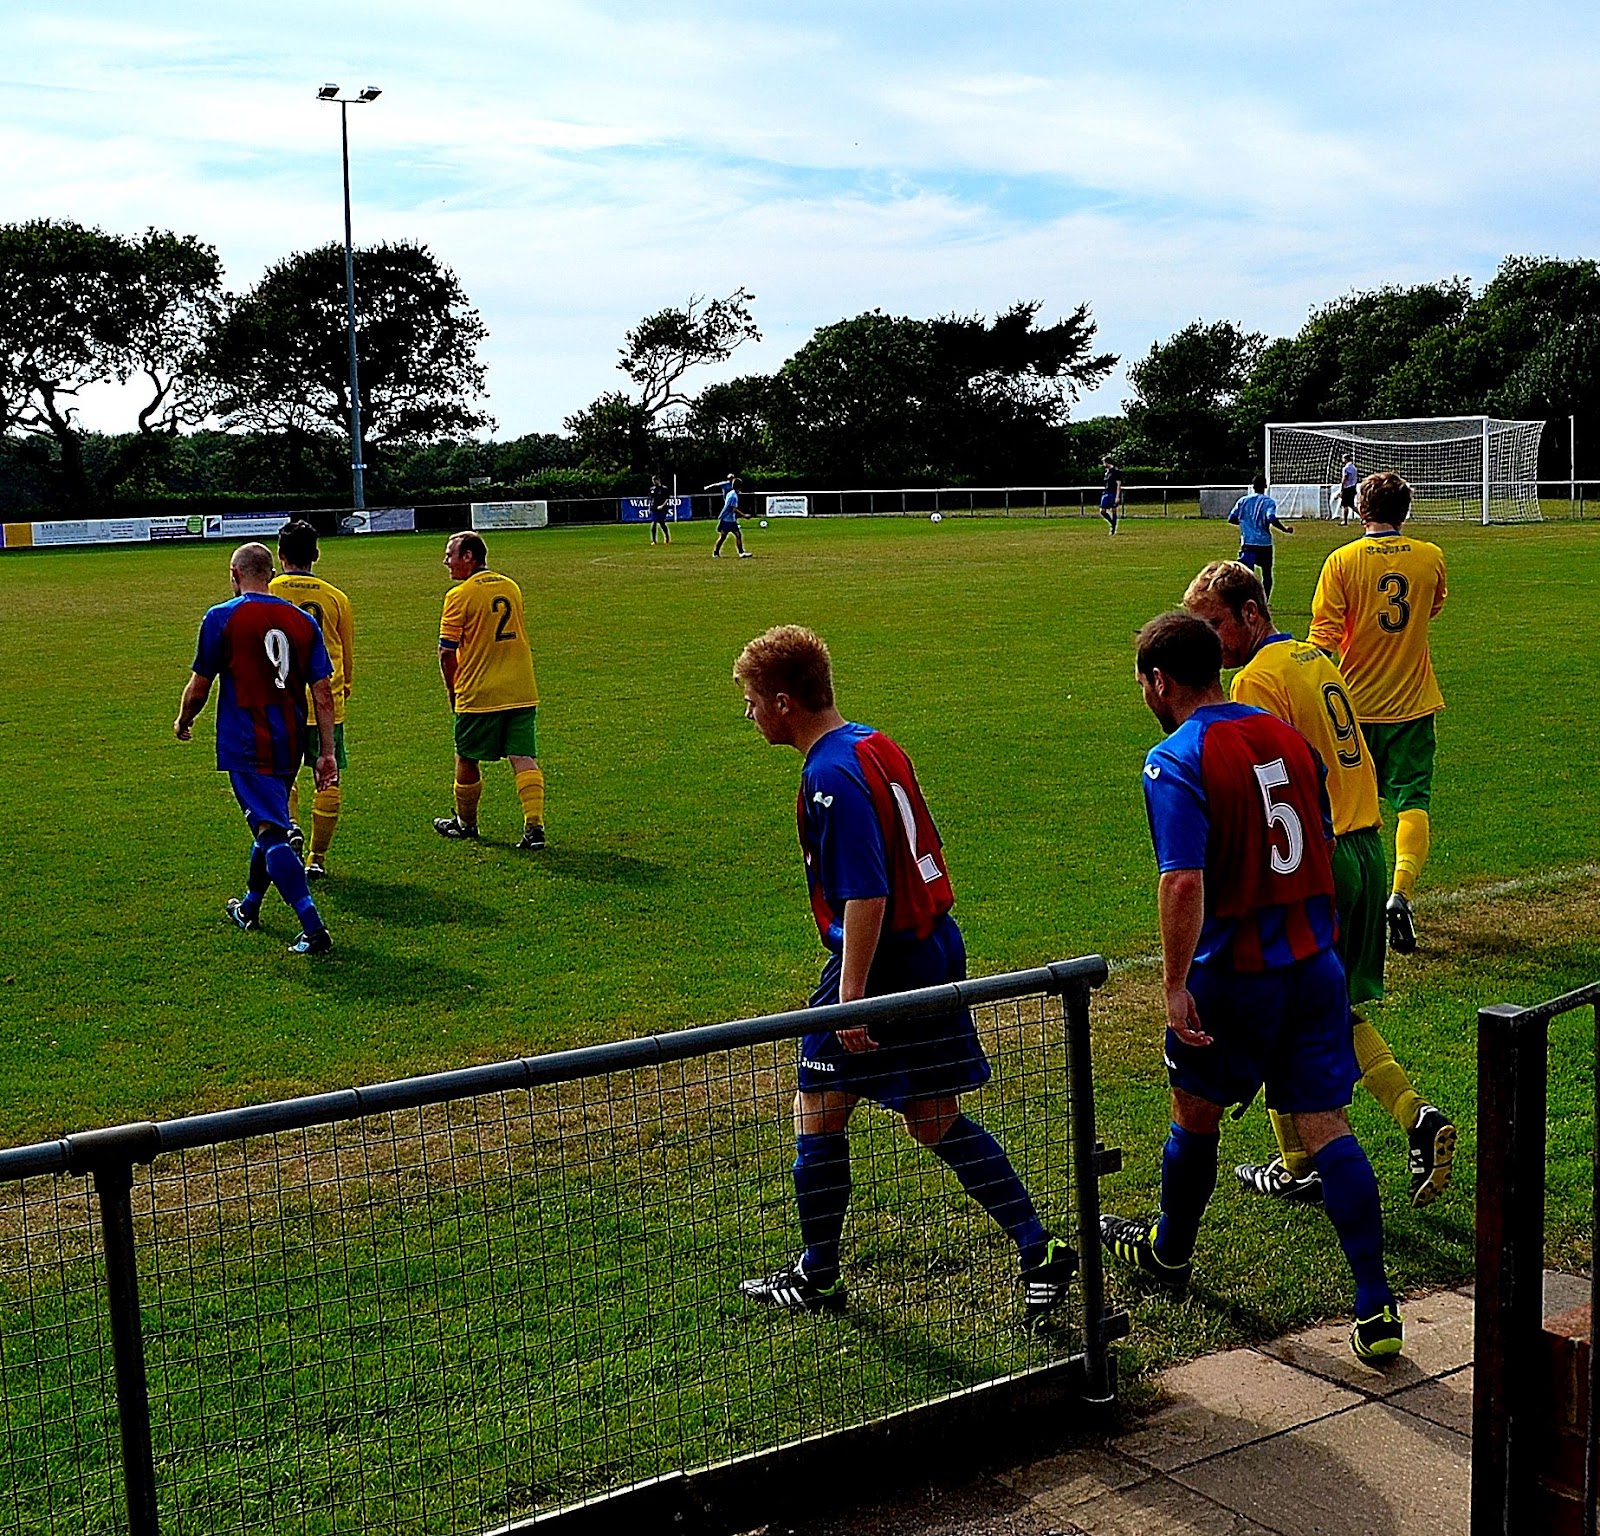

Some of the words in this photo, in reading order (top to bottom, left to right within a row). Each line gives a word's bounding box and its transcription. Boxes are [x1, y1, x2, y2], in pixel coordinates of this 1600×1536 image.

[491, 595, 517, 642] 2
[1377, 572, 1411, 634] 3
[264, 628, 290, 689] 9
[1321, 682, 1363, 768] 9
[1253, 757, 1304, 875] 5
